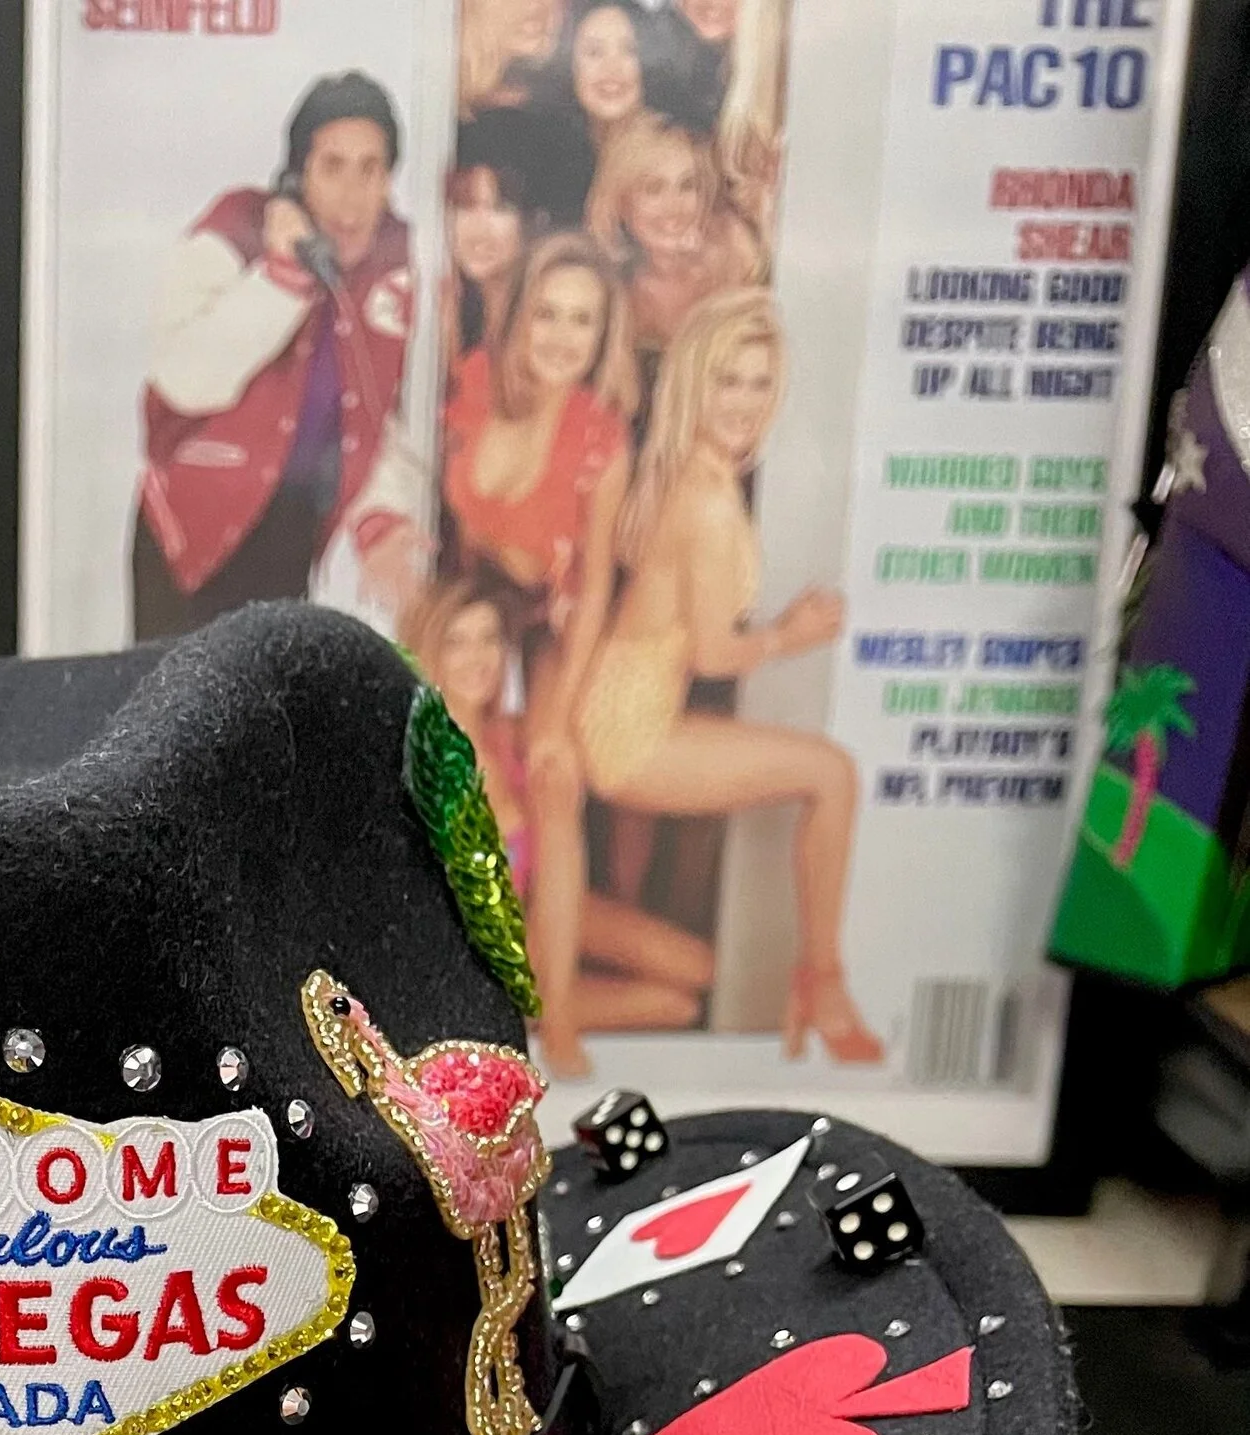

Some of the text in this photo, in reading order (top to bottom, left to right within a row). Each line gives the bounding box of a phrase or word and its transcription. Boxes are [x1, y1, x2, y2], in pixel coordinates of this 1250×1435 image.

[989, 168, 1133, 210] RHONDA
[1015, 220, 1132, 262] SHEAR
[908, 268, 1129, 304] LOOKING GOOD
[902, 316, 1123, 352] DESPITE BEING
[912, 363, 1116, 399] UP ALL NIGHT
[886, 454, 1019, 489] MARRIED
[948, 501, 1011, 537] AND
[979, 548, 1100, 584] WOMEN
